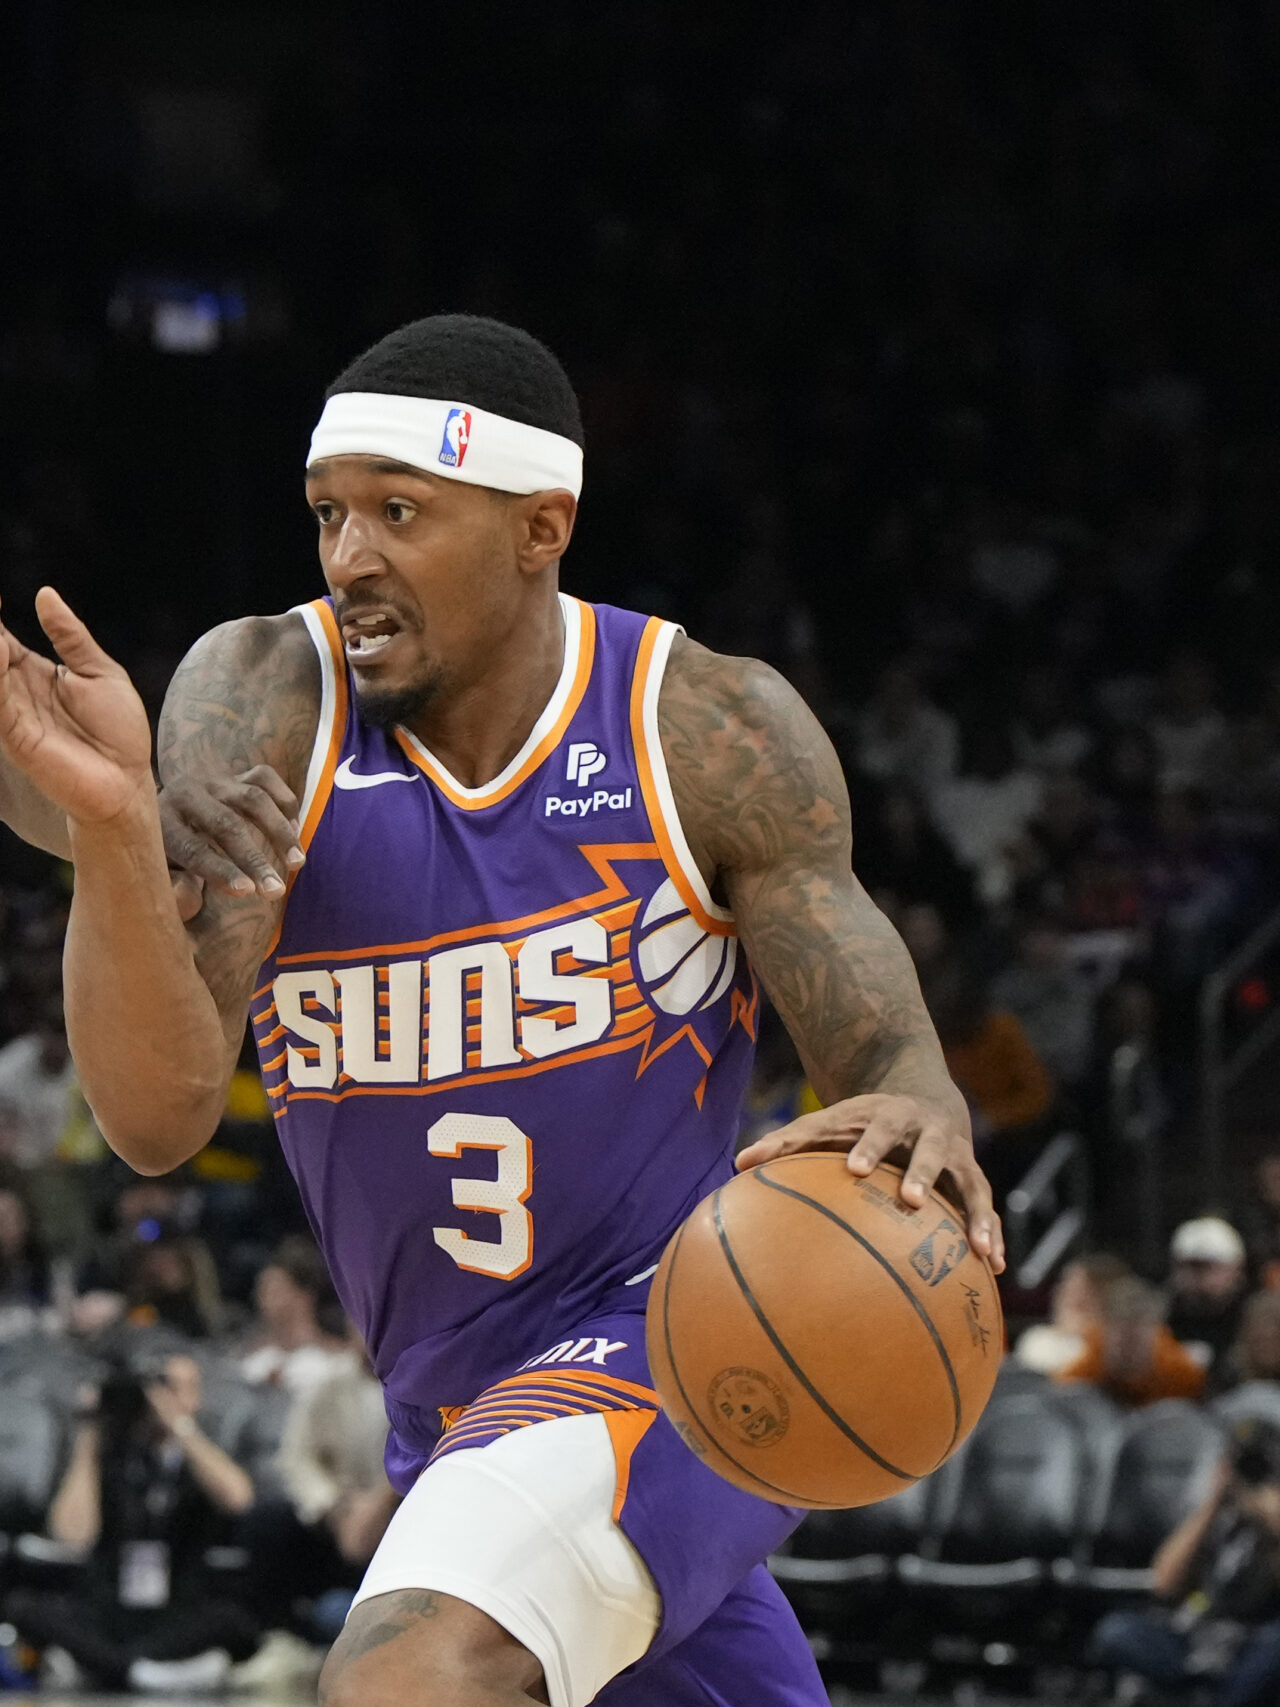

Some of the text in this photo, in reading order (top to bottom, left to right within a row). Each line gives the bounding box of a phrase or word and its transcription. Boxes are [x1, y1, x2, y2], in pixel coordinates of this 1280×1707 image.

[545, 787, 632, 817] PayPal
[273, 917, 613, 1089] SUNS
[426, 1111, 534, 1282] 3
